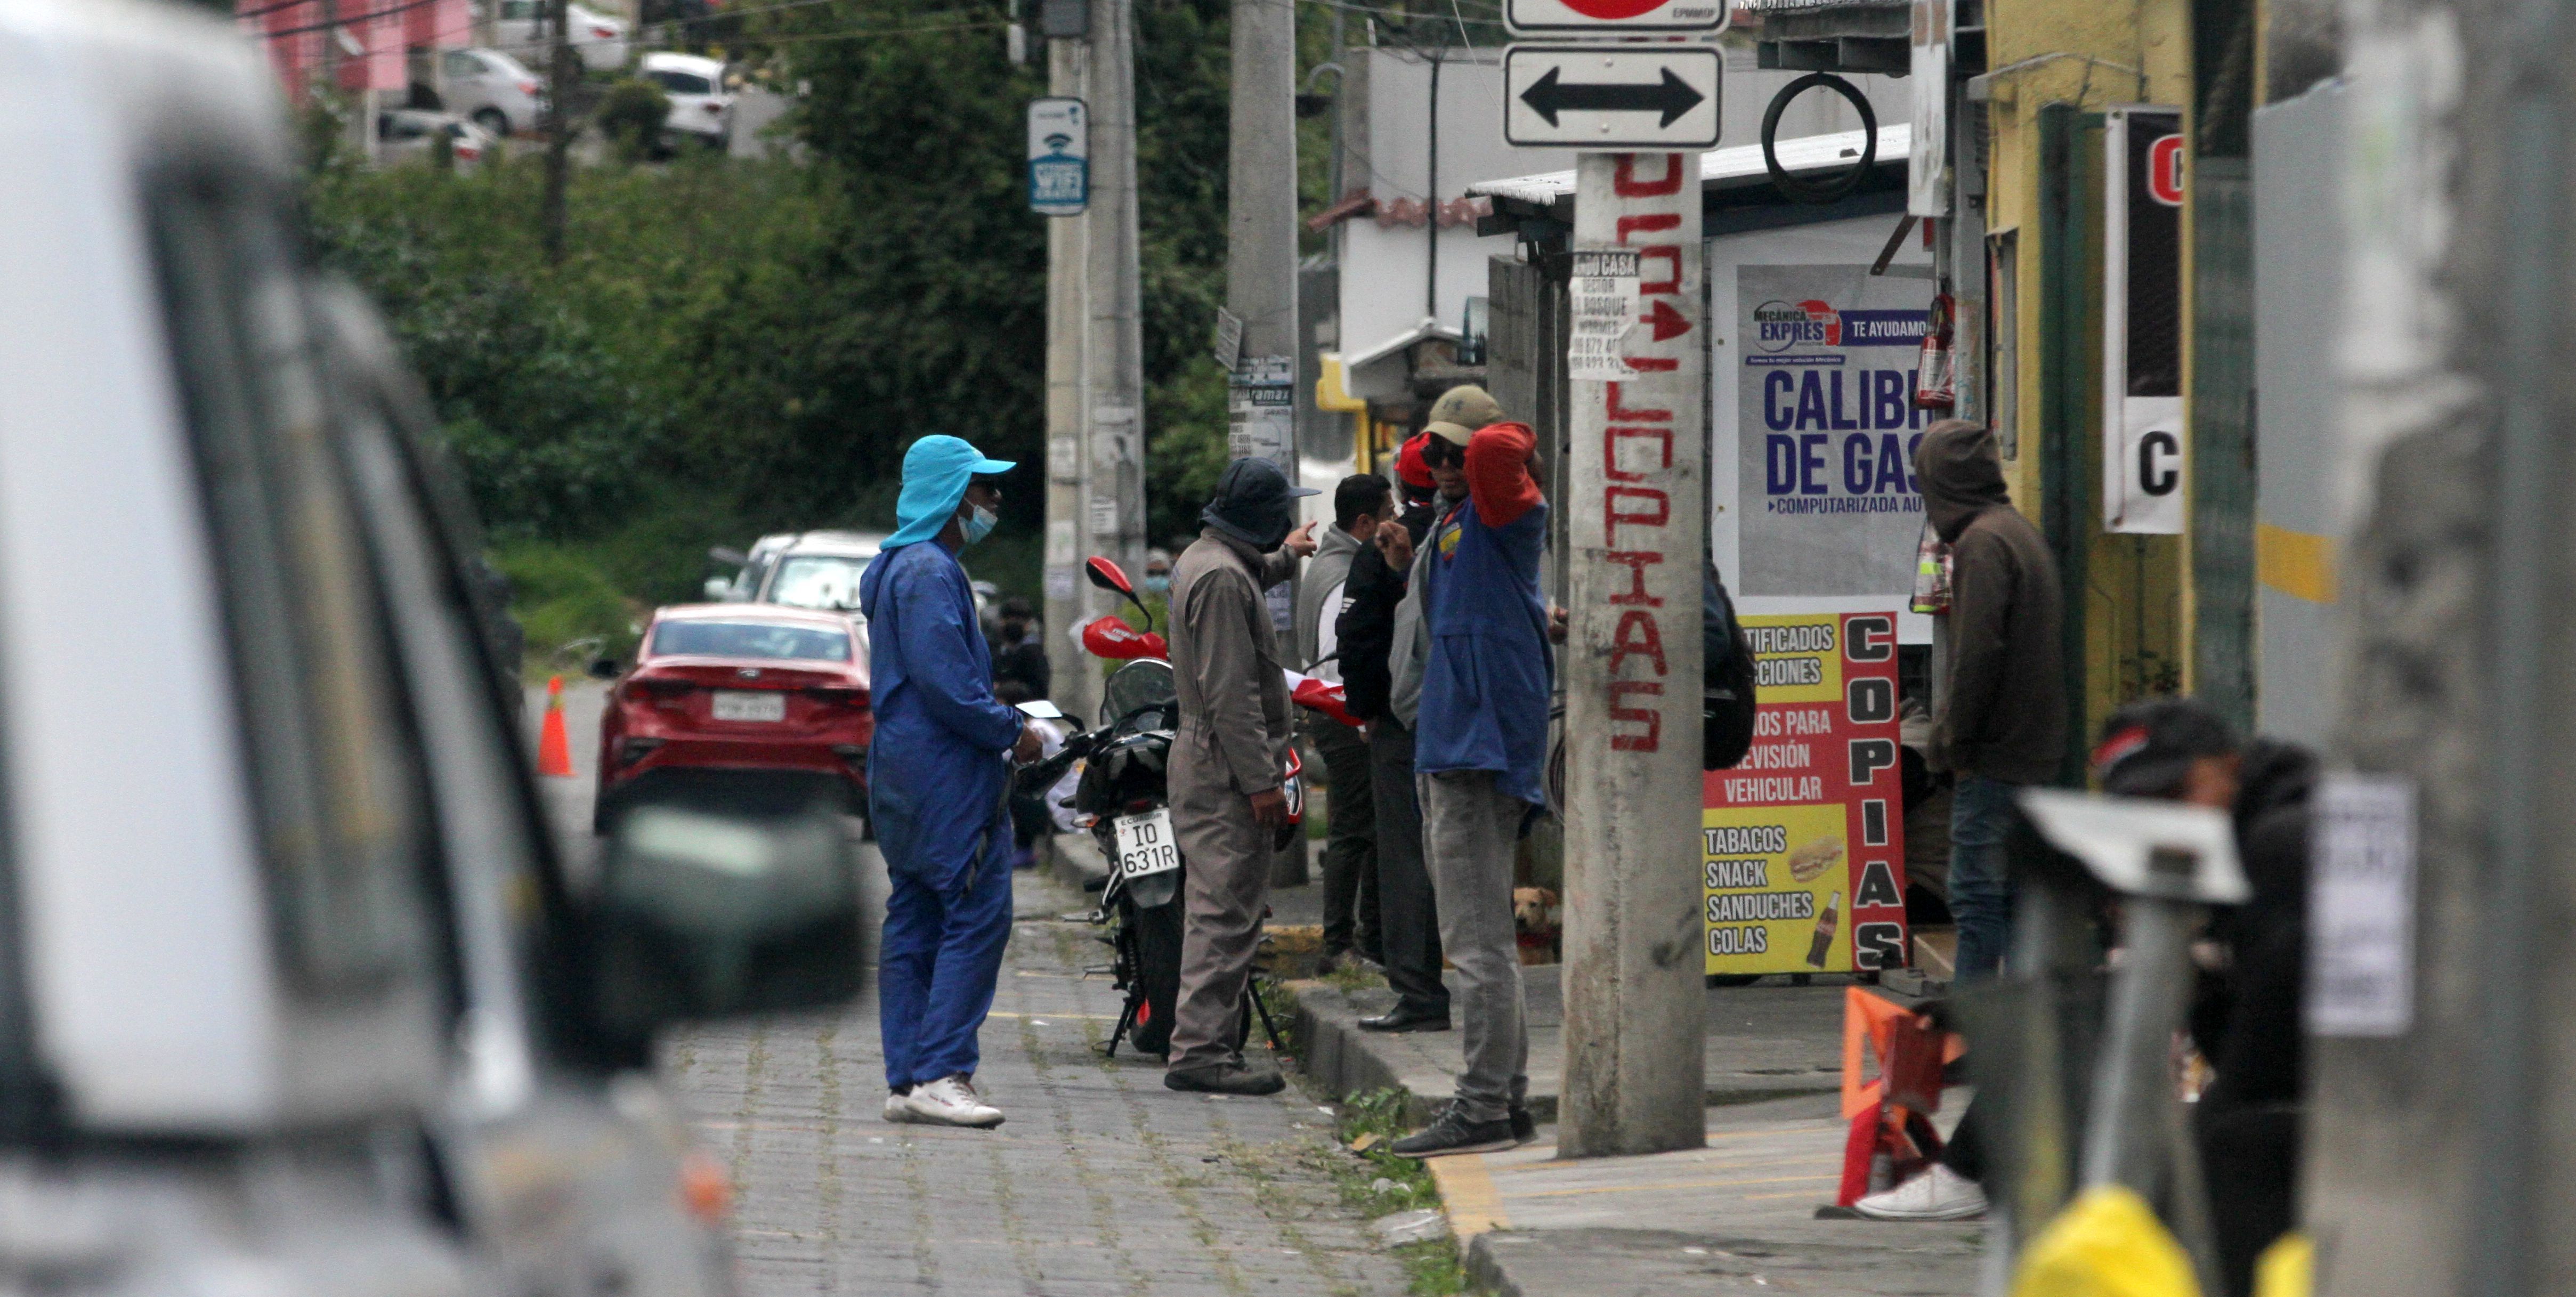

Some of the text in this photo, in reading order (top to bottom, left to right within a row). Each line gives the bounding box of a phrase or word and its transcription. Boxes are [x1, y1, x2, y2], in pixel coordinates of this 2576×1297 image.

[1601, 254, 1636, 275] CASA
[1584, 297, 1627, 315] BOSQUE
[1853, 320, 1926, 337] TE AYUDAMO
[1767, 433, 1828, 495] DE
[1777, 498, 1899, 514] COMPUTARIZADA
[1744, 624, 1834, 652] TIFICADOS
[1786, 709, 1832, 735] PARA
[1724, 776, 1822, 802] VEHICULAR
[1845, 616, 1903, 970] COPIAS
[1705, 826, 1786, 854] TABACOS
[1123, 845, 1174, 873] 631R
[1706, 860, 1768, 888] SNACK
[1708, 893, 1813, 921] SANDUCHES
[1709, 927, 1767, 954] COLAS
